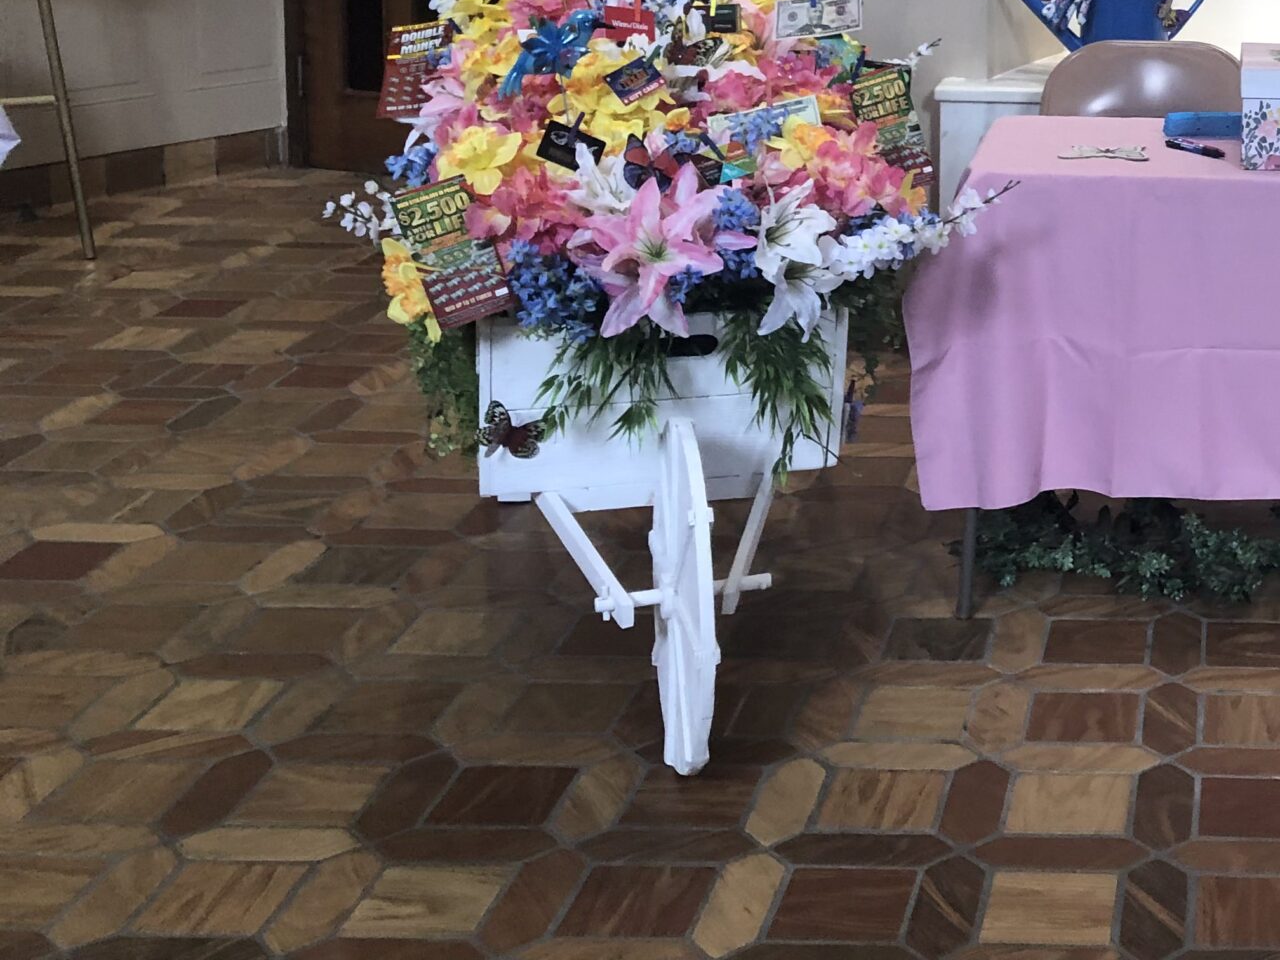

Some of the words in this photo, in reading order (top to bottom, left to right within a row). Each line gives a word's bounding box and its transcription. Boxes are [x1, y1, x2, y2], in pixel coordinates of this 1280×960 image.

[400, 25, 446, 43] DOUBLE
[399, 191, 471, 227] $2,500
[433, 212, 468, 237] LIF
